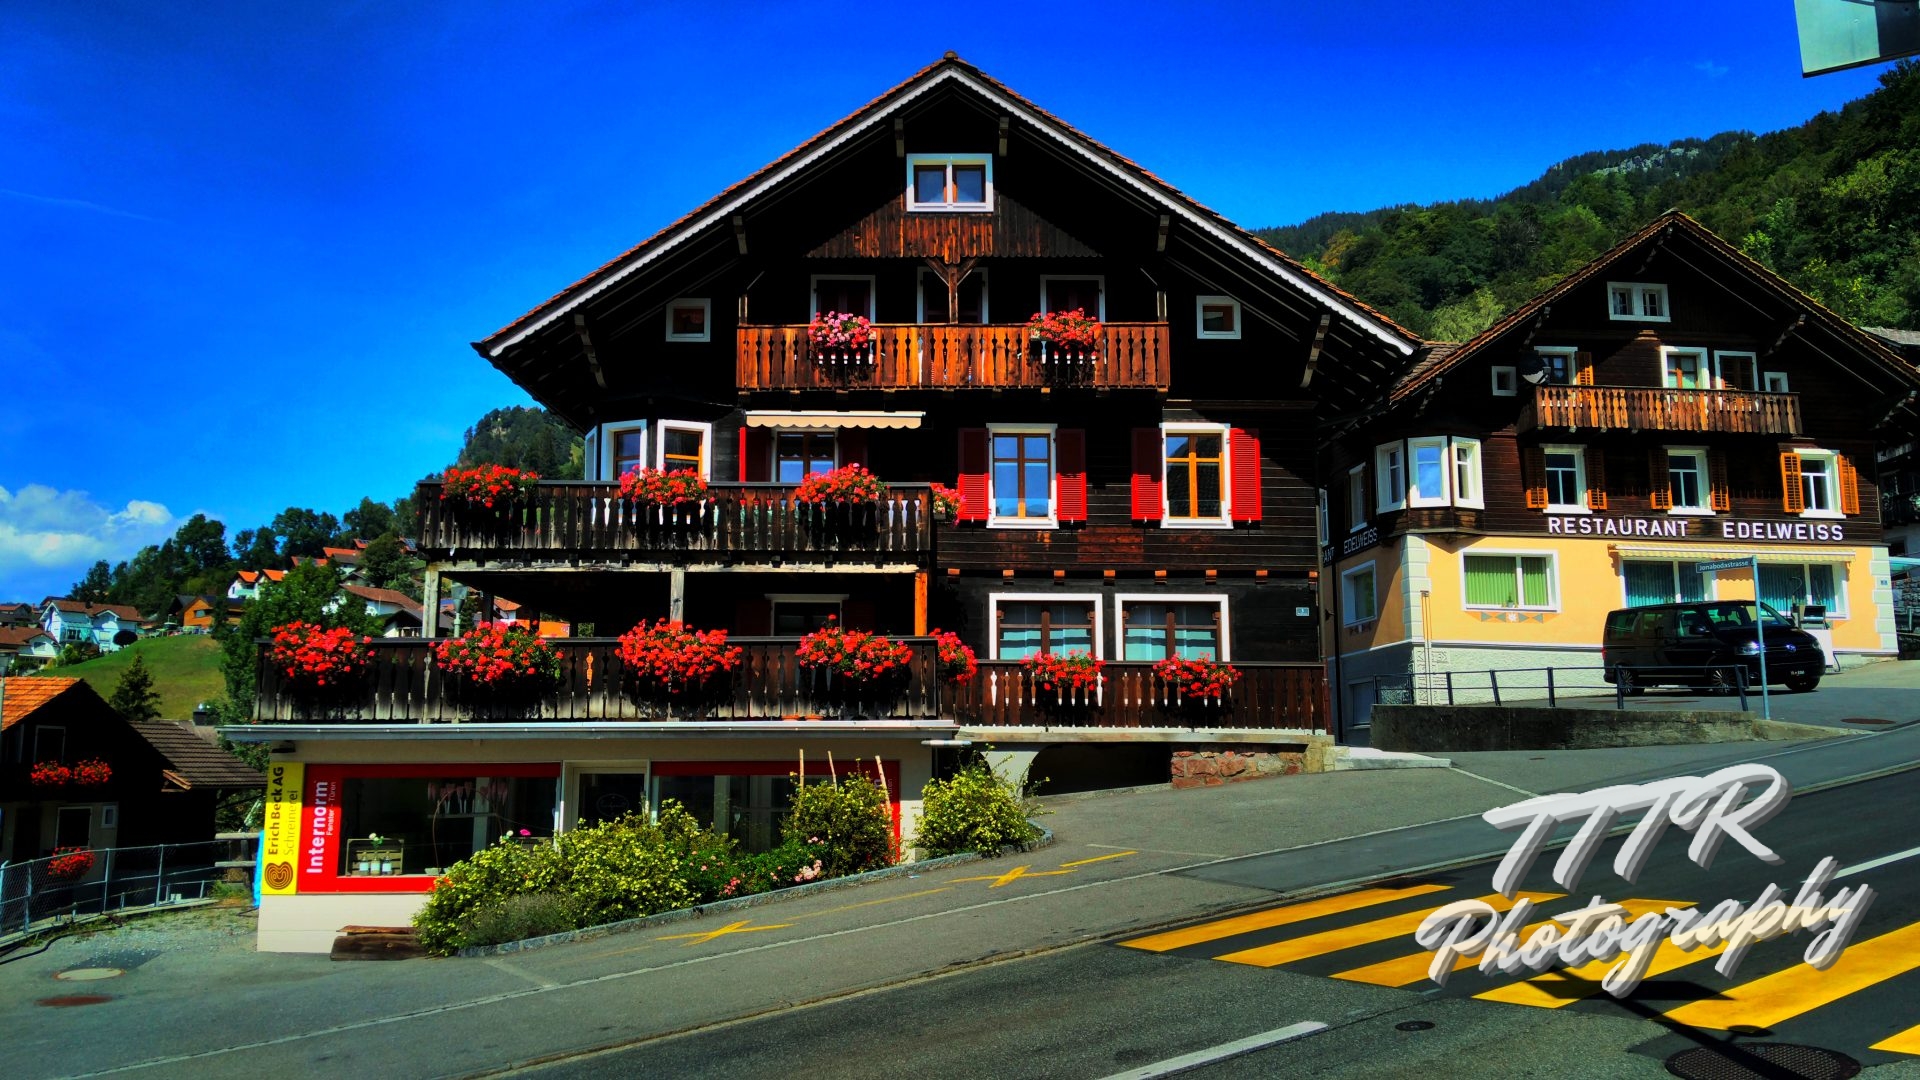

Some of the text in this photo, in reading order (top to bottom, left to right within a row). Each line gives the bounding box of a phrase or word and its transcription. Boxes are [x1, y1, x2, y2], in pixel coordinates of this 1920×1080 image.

[1343, 527, 1378, 555] EDELWEISS
[1548, 517, 1843, 541] RESTAURANT EDELWEISS
[268, 767, 284, 855] Erich Beck AG
[284, 790, 298, 856] Schreinerei
[306, 781, 328, 874] Internorm
[326, 809, 335, 836] Fenster
